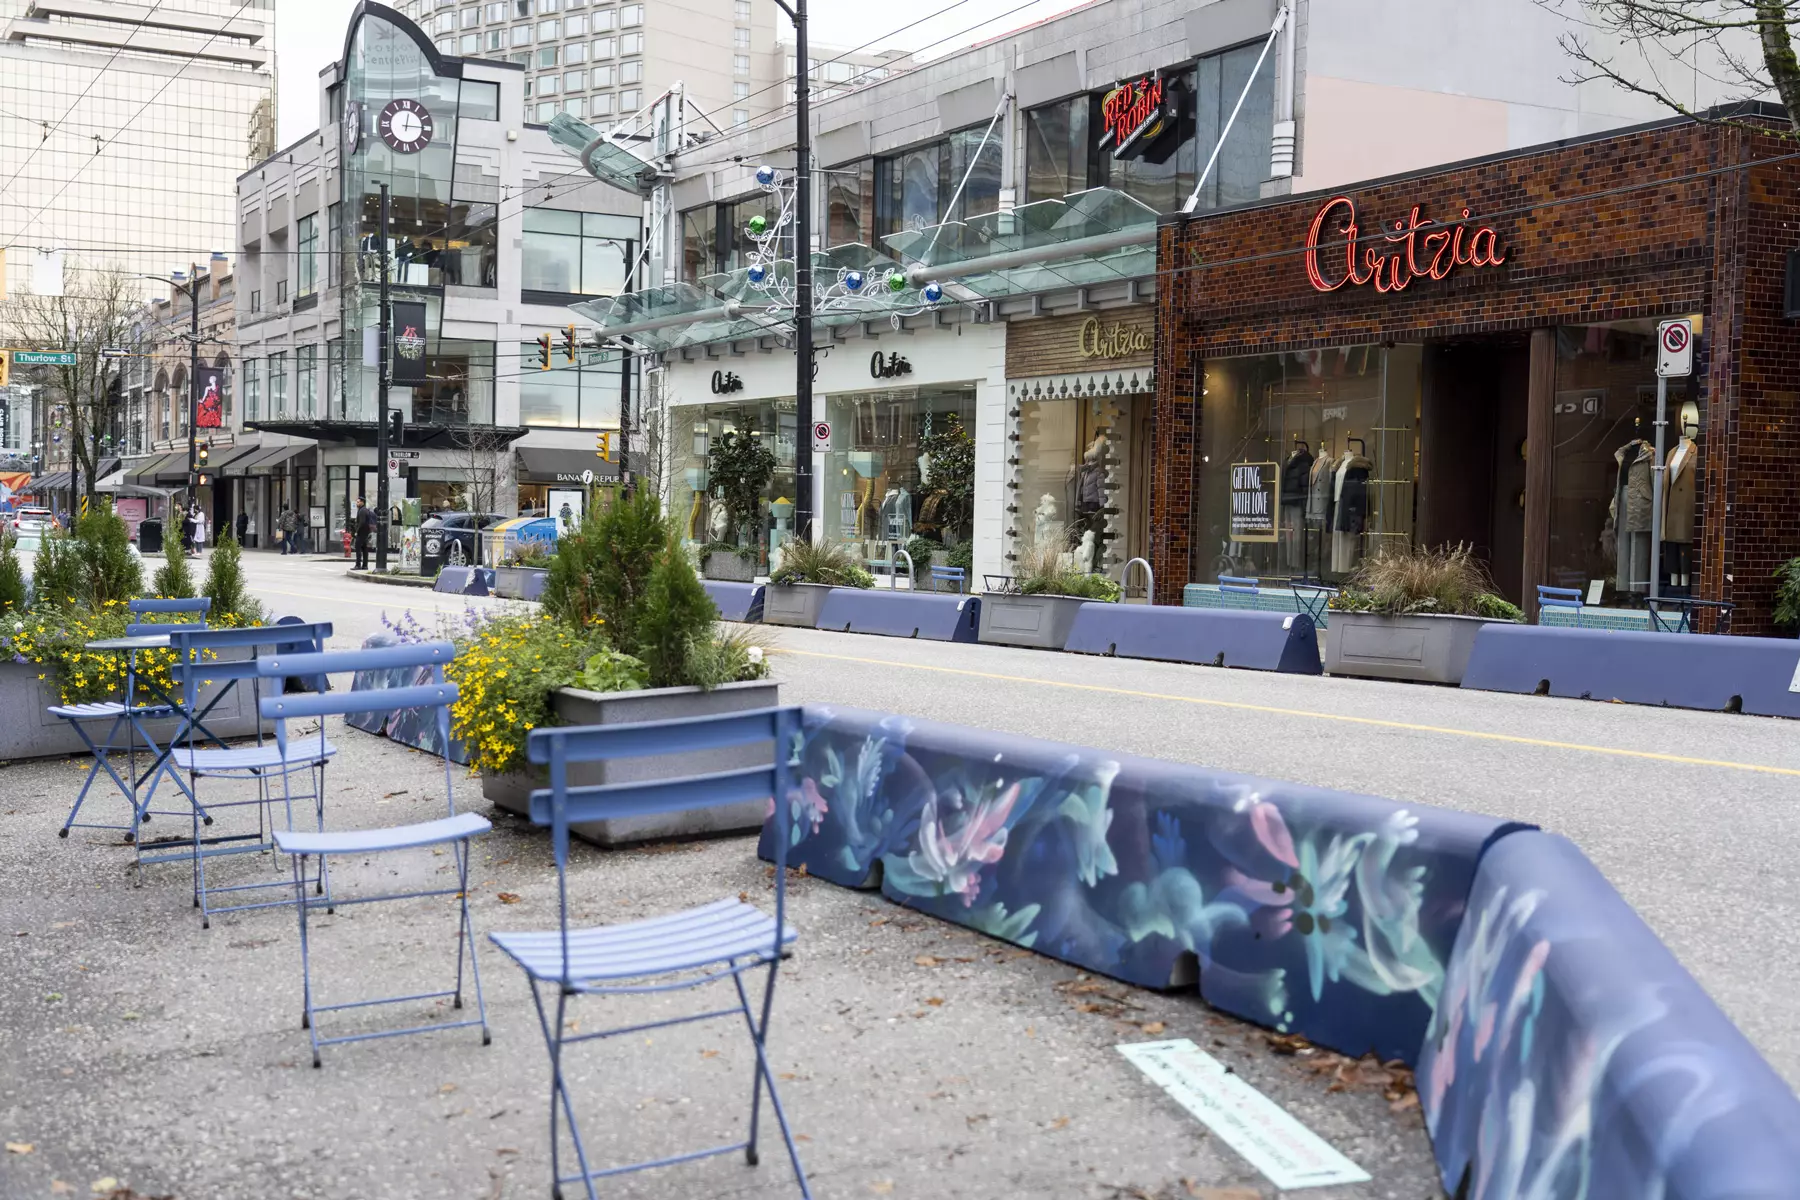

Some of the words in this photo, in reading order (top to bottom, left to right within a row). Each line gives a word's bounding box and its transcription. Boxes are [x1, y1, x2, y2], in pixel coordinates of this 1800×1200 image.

[1104, 82, 1133, 132] RED
[1116, 76, 1162, 146] ROBIN
[1305, 195, 1506, 293] Aritzia
[1079, 316, 1148, 359] Aritzia
[18, 353, 56, 363] Thurlow
[60, 354, 72, 363] St
[557, 473, 584, 482] BANAN
[1233, 466, 1261, 491] GIFTING,
[1232, 491, 1250, 514] WITH
[1251, 491, 1268, 514] LOVE
